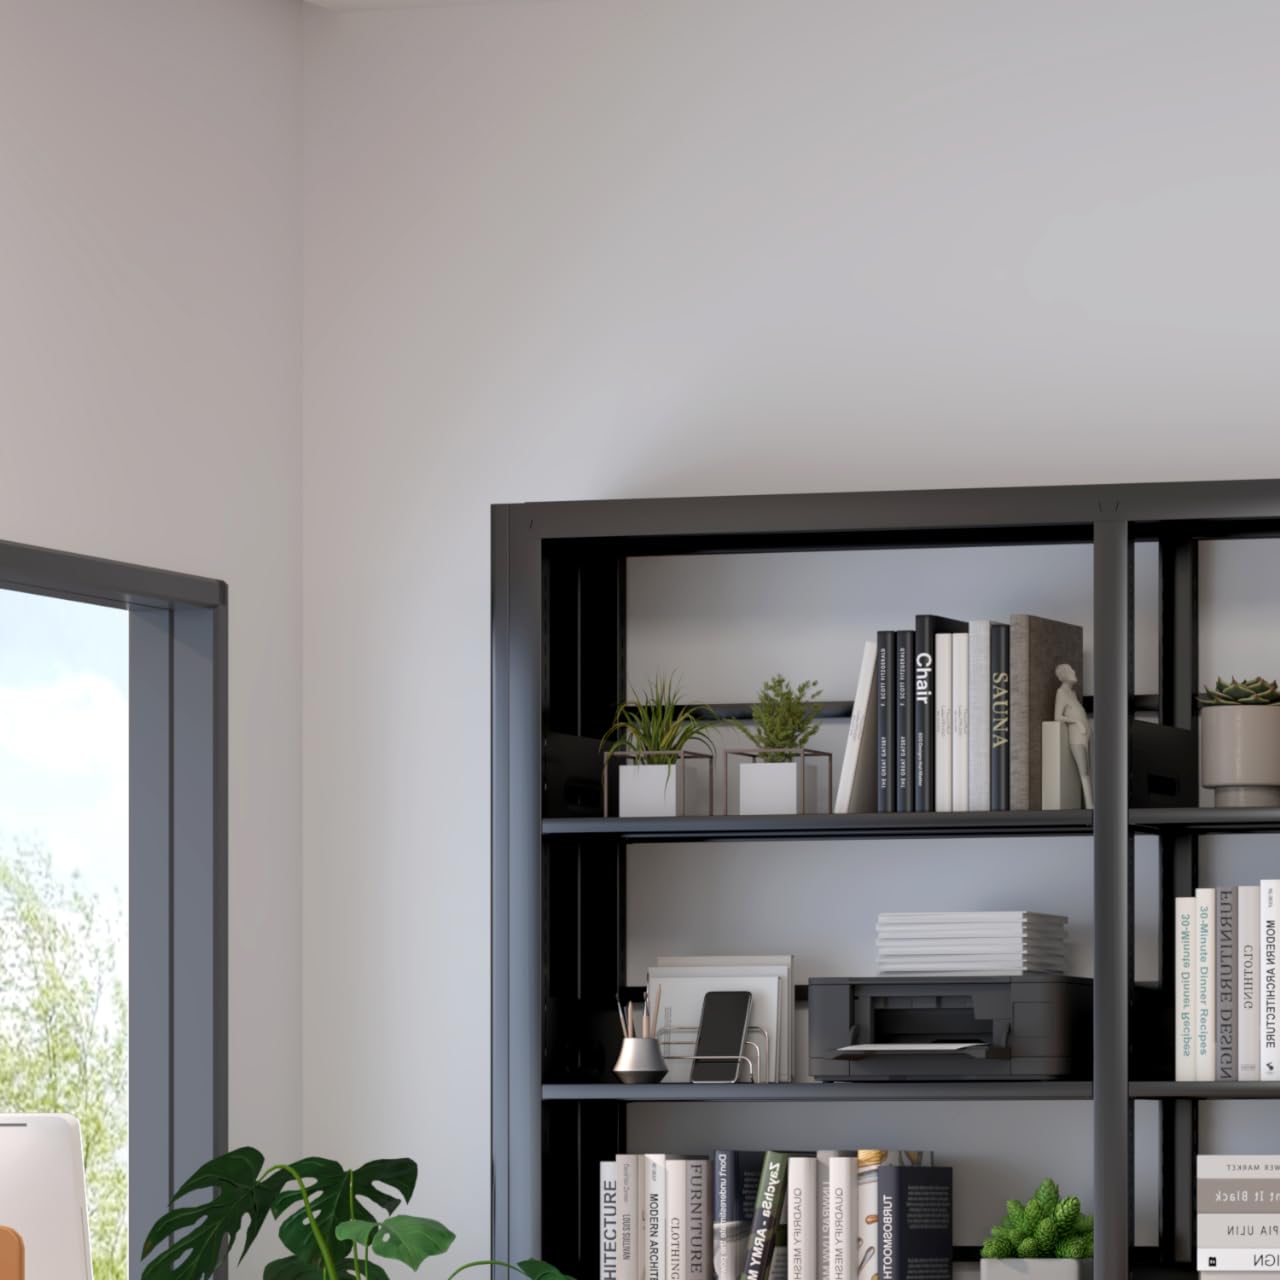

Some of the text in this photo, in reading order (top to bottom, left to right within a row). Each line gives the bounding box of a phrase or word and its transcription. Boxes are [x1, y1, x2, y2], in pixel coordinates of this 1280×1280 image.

[916, 652, 932, 704] Chair
[992, 671, 1009, 749] SAUNA
[1198, 905, 1209, 1056] 30-Minute Dinner Recipes
[622, 1214, 631, 1232] LOUIS
[650, 1193, 659, 1237] MODERN
[690, 1163, 703, 1273] FURNITURE
[622, 1232, 631, 1261] SULLIVAN
[671, 1217, 680, 1280] CLOTHING
